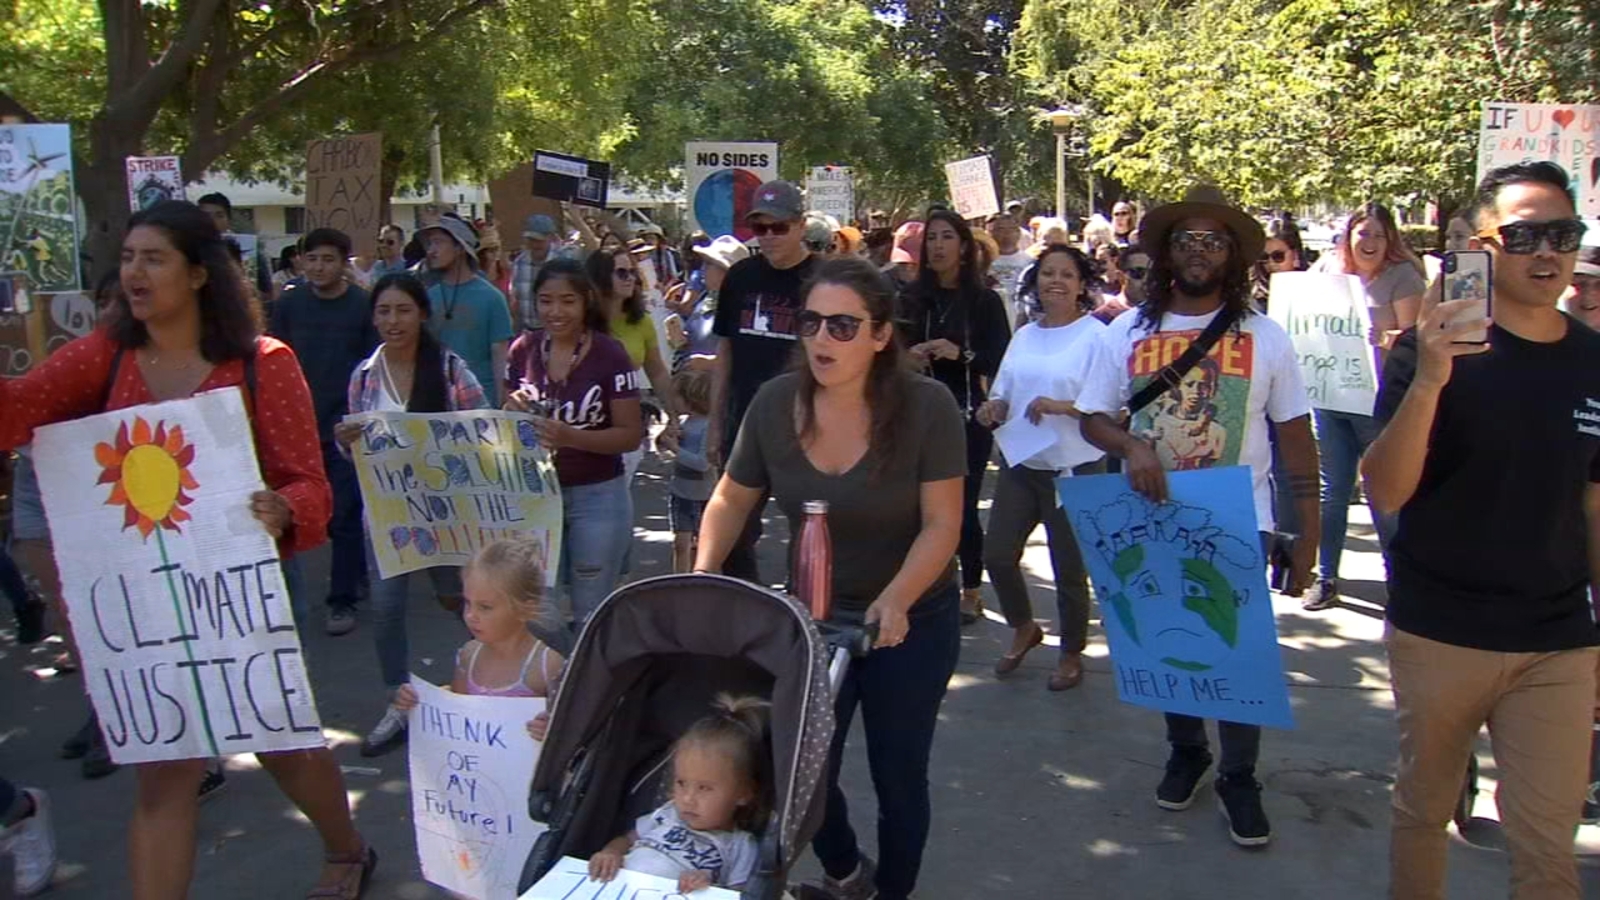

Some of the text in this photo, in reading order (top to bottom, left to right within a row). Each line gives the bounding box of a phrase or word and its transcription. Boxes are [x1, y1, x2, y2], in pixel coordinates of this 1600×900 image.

[1486, 106, 1518, 129] IF
[1525, 110, 1543, 133] U
[696, 153, 769, 168] NO SIDES
[1482, 135, 1597, 155] GRANDKIDS
[129, 159, 176, 172] STRIKE
[310, 174, 375, 206] TAX
[1134, 334, 1245, 376] HOE
[405, 493, 525, 523] NOT THE
[91, 558, 295, 652] CLIMATE
[1119, 664, 1178, 699] HELP
[103, 648, 320, 747] JUSTICE
[420, 701, 507, 749] THINK
[447, 751, 480, 772] OF
